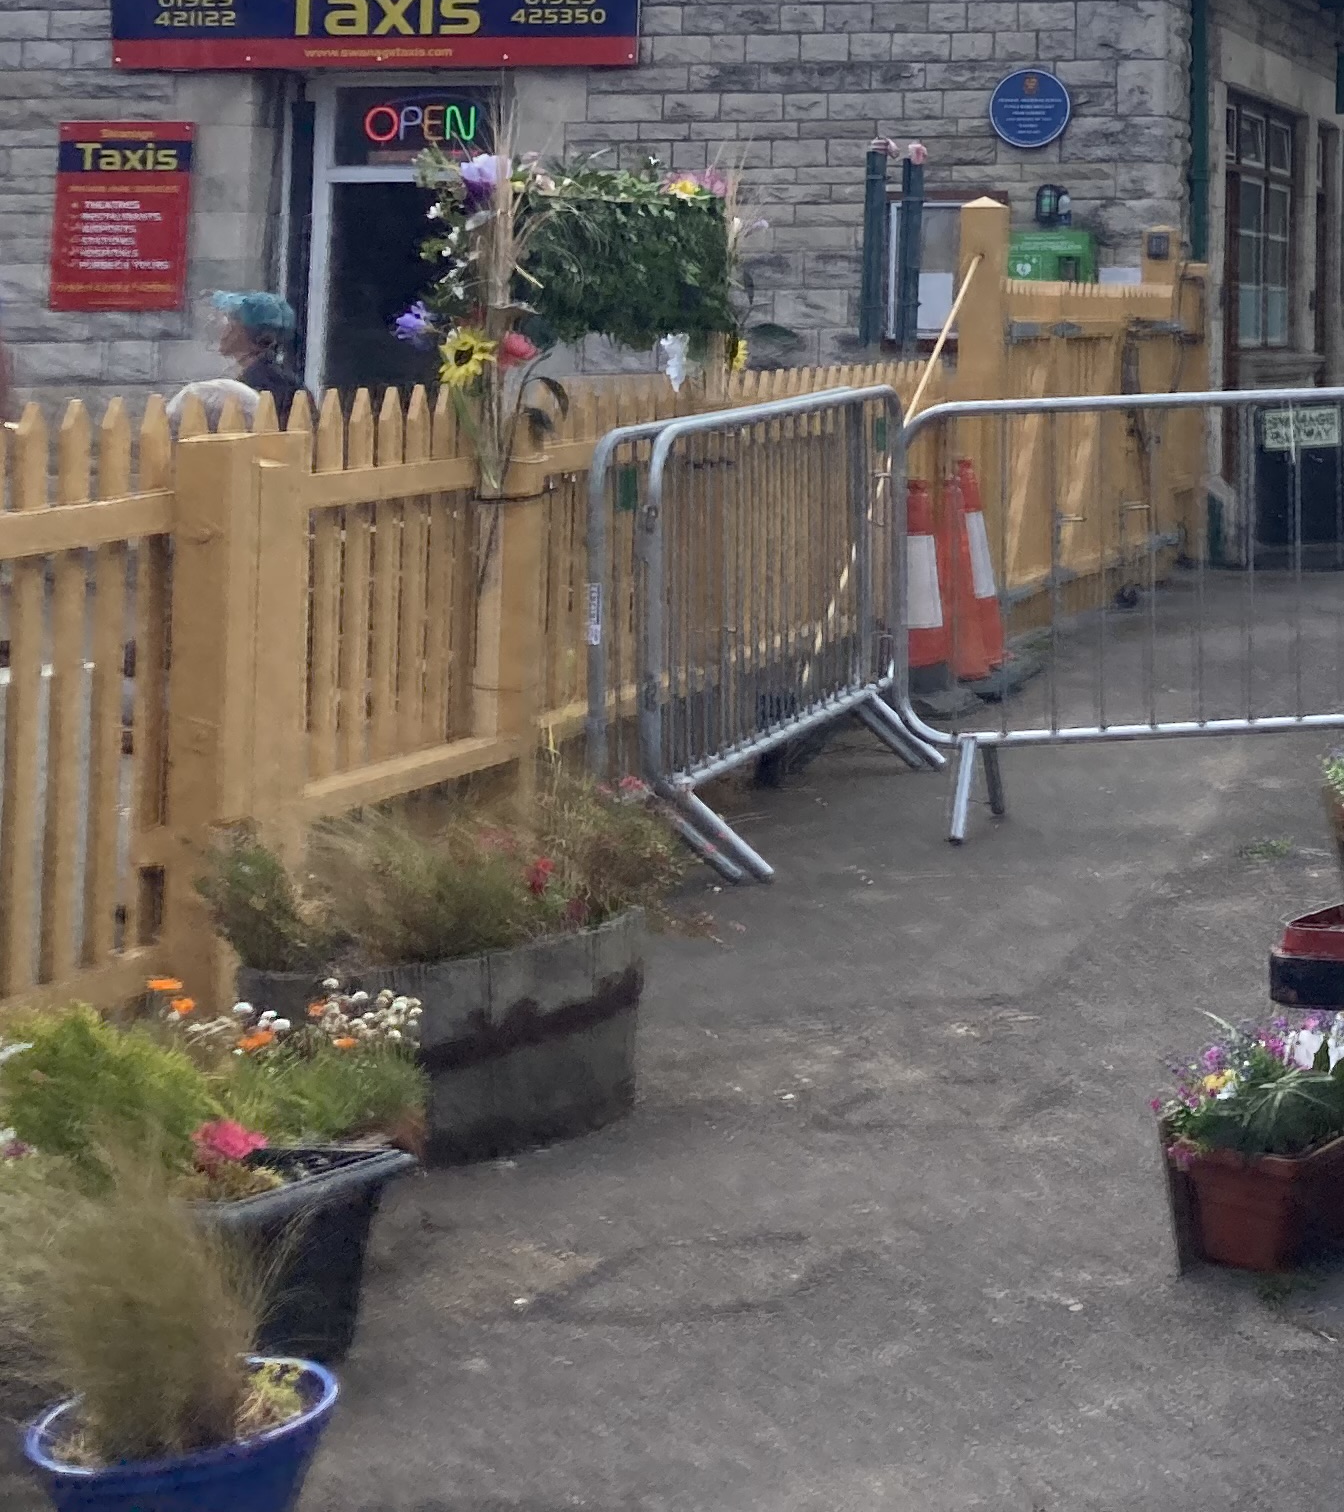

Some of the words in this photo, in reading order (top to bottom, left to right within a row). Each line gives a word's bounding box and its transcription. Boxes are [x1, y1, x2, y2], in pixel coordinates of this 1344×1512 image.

[154, 10, 237, 27] 421122
[510, 8, 607, 25] 425350
[364, 105, 476, 142] OPEN
[75, 142, 179, 171] Taxis
